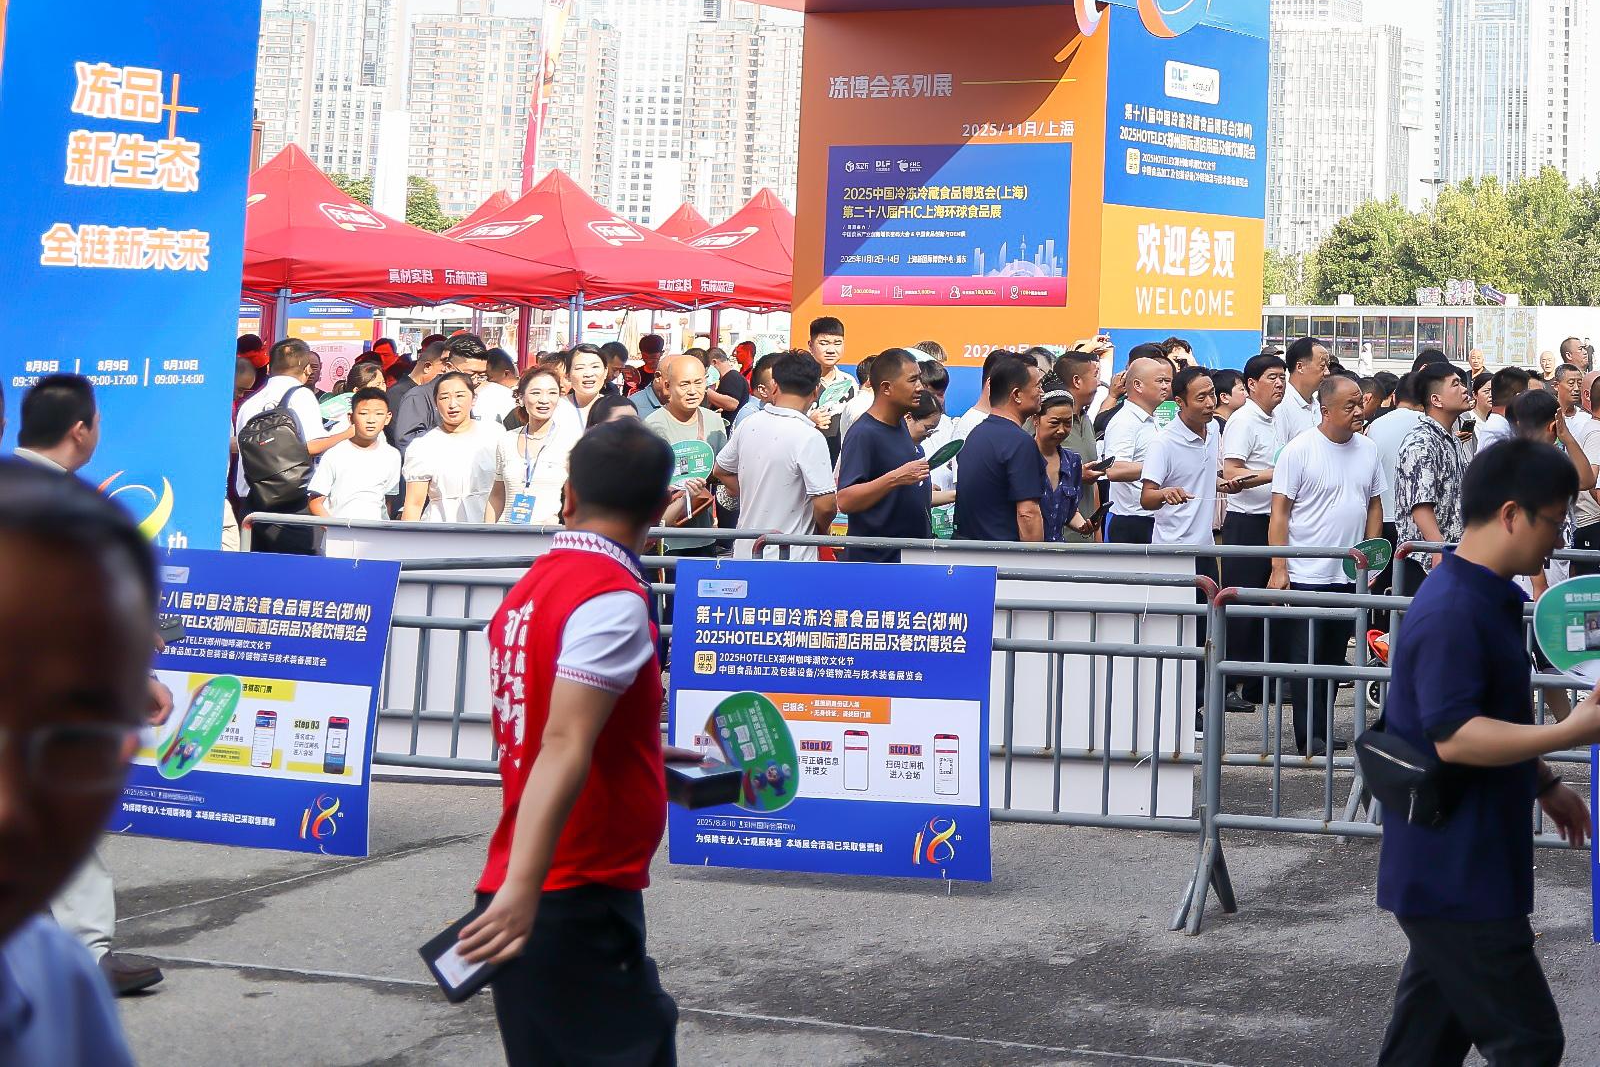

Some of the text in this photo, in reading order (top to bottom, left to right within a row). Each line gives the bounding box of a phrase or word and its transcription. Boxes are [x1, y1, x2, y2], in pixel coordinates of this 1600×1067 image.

[828, 74, 953, 98] 冻博会系列展
[64, 130, 200, 192] 新生态
[843, 186, 1028, 201] 2025中国冷冻冷藏食品博览会(上海)
[842, 205, 1002, 219] 第二十八届FHC上海环球食品展
[41, 223, 209, 271] 全链新未来
[1136, 224, 1235, 279] 欢迎参观
[1135, 286, 1235, 317] WELCOME
[26, 360, 198, 372] 8月8日 8月9日 8月10日
[160, 614, 368, 642] TELEX郑州国际酒店用品及餐饮博览会
[696, 606, 968, 633] 第十八届中国冷冻冷藏食品博览会(郑州)
[695, 630, 967, 654] 2025HOTELEX郑州国际酒店用品及餐饮博览会
[719, 653, 855, 666] 2025HOTELEX郑州咖啡潮饮文化节
[821, 741, 831, 751] 02
[890, 745, 921, 755] step 03
